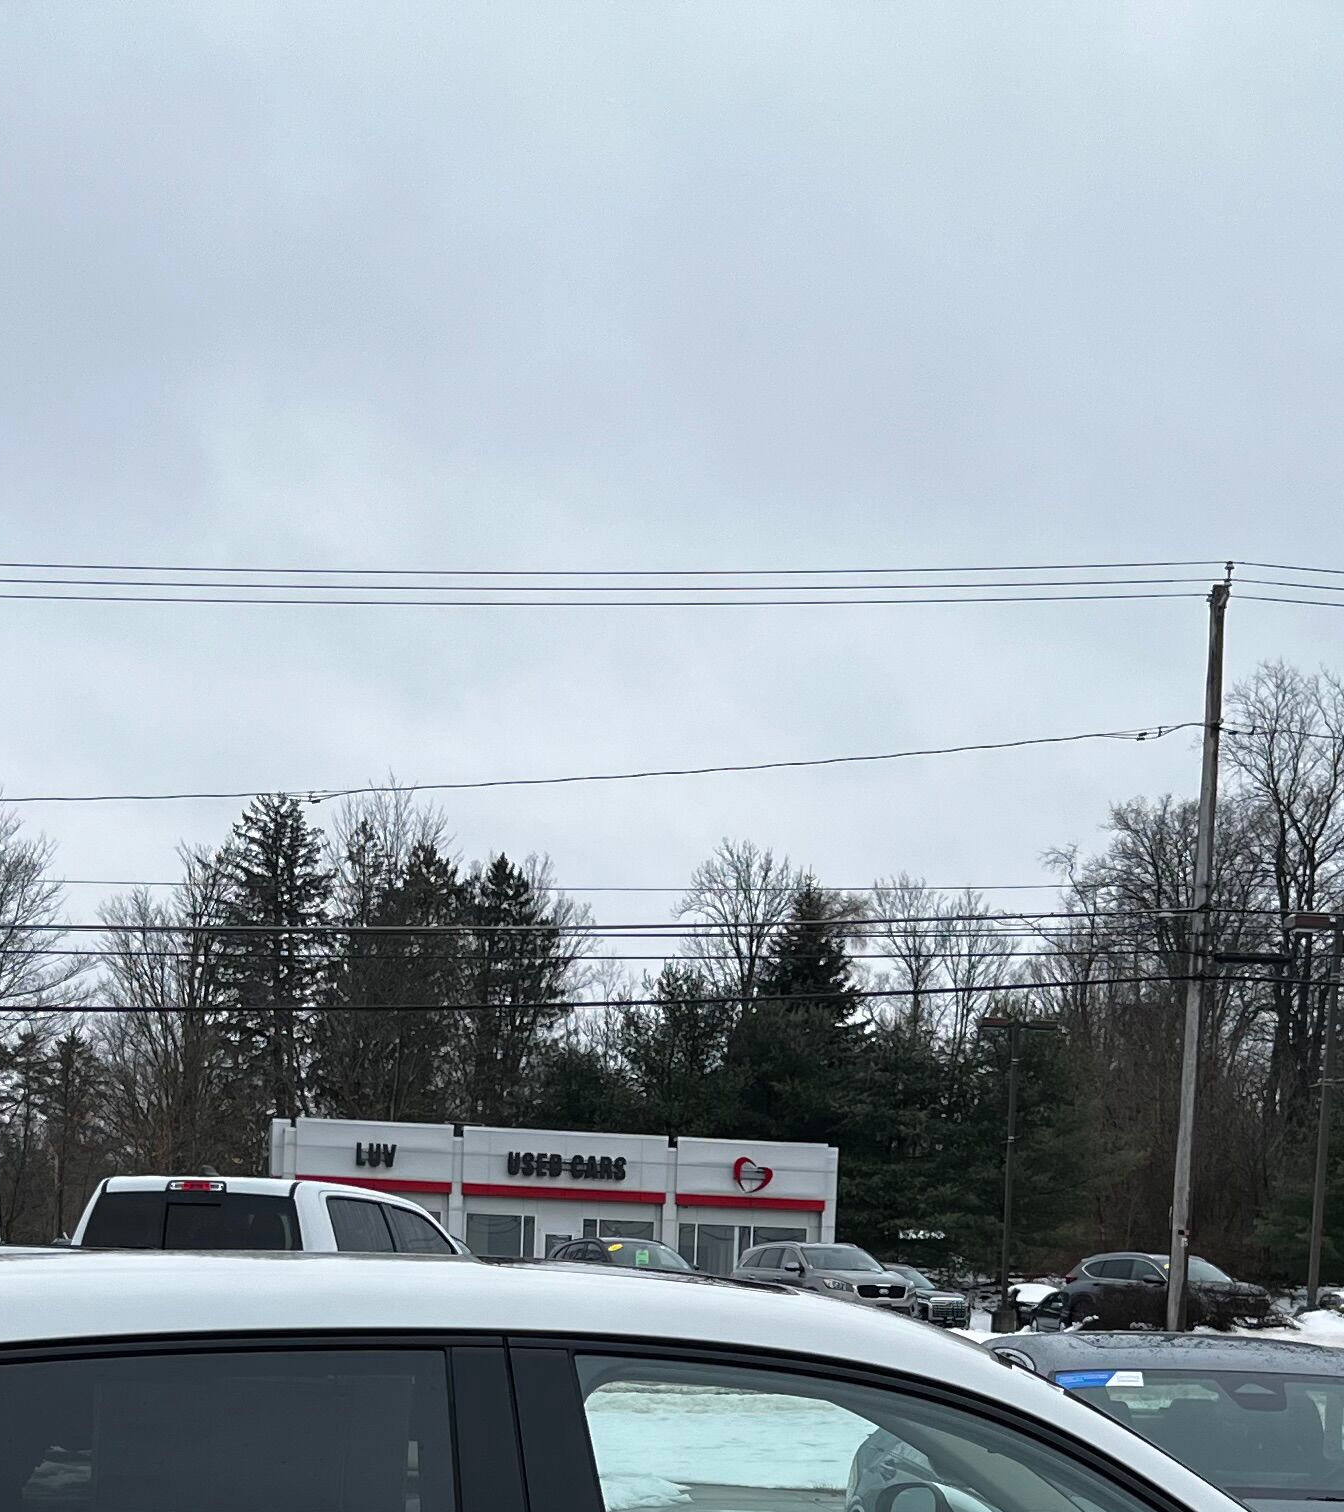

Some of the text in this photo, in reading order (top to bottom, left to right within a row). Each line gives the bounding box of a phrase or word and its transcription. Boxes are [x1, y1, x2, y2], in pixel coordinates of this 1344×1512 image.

[356, 1142, 397, 1168] LUV
[508, 1151, 627, 1181] USED CARS
